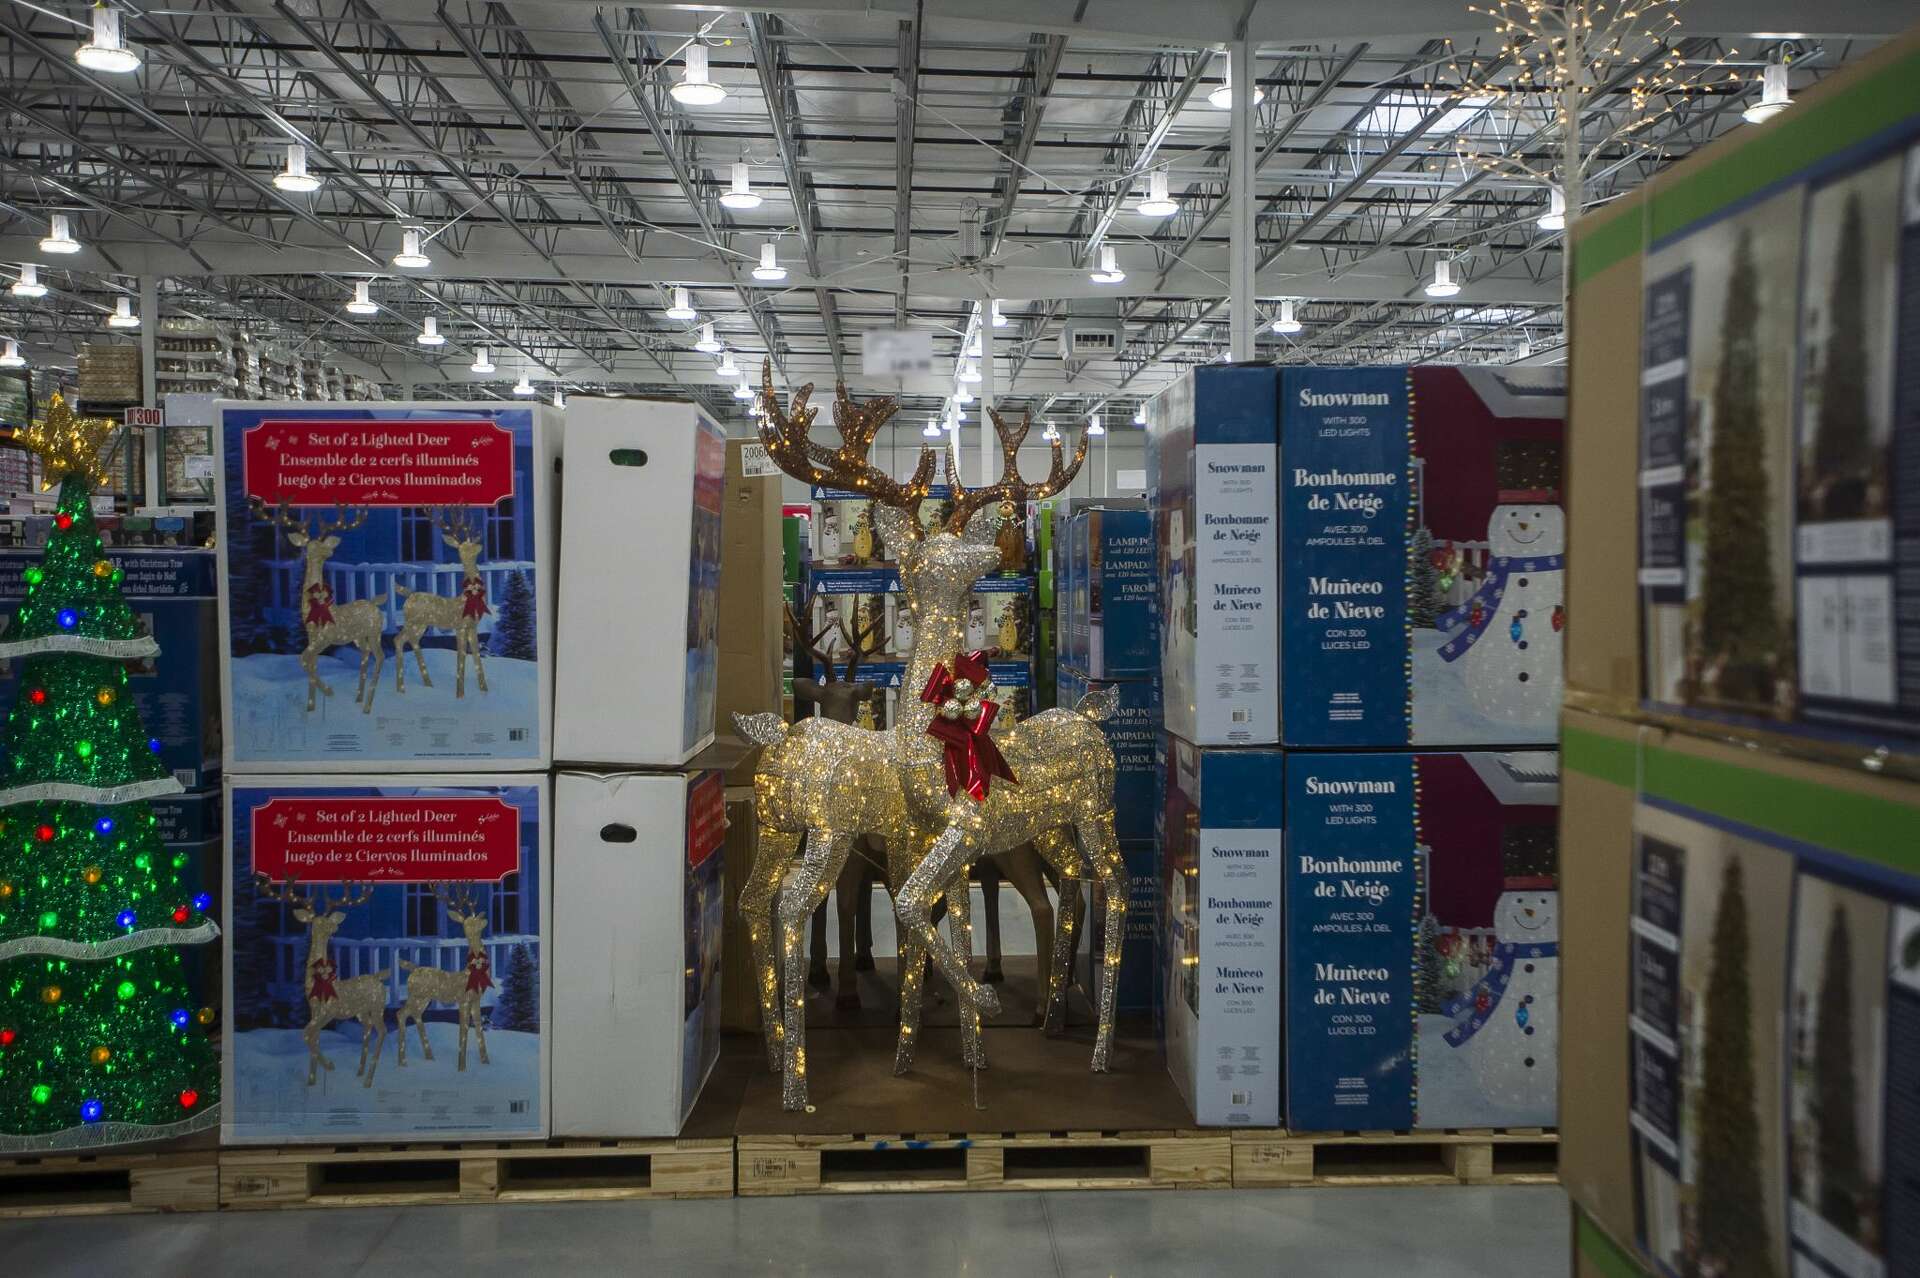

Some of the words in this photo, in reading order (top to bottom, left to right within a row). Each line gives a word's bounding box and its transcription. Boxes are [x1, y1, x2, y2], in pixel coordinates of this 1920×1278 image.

[1299, 388, 1389, 407] Snowman
[136, 408, 160, 425] 300
[1322, 416, 1348, 425] WITH
[1348, 415, 1367, 425] 300
[1318, 428, 1338, 437] LED
[1338, 427, 1371, 437] LIGHTS
[308, 433, 330, 446] Set
[333, 432, 349, 446] of
[350, 436, 359, 446] 2
[361, 432, 414, 449] Lighted
[417, 432, 450, 446] Deer
[280, 452, 348, 466] Ensemble
[349, 452, 367, 466] de
[369, 456, 377, 466] 2
[379, 453, 414, 466] cerfs
[416, 452, 479, 466] illuminés
[1208, 462, 1266, 474] Snowman
[278, 472, 317, 489] Juego
[318, 472, 336, 488] de
[338, 476, 347, 486] 2
[348, 473, 401, 486] Ciervos
[404, 472, 482, 486] Iluminados
[1293, 468, 1396, 487] Bonhomme
[1307, 493, 1330, 511] de
[1334, 492, 1383, 519] Neige
[1204, 513, 1270, 525] Bonhomme
[1213, 529, 1227, 541] de
[1230, 528, 1261, 543] Neige
[1322, 525, 1348, 534] AVEC
[1349, 525, 1369, 534] 300
[1108, 537, 1137, 546] LAMP
[1305, 537, 1357, 546] AMPOULES
[1357, 536, 1366, 545] À
[1366, 536, 1385, 546] DEL
[1214, 583, 1261, 595] Muñeco
[1308, 576, 1383, 595] Muñeco
[1213, 599, 1227, 611] de
[1230, 599, 1262, 611] Nieve
[1307, 602, 1330, 619] de
[1334, 600, 1385, 619] Nieve
[1325, 629, 1347, 638] CON
[1348, 629, 1367, 638] 300
[1321, 640, 1352, 650] LUCES
[1351, 640, 1371, 650] LED
[1306, 776, 1396, 795] Snowman
[1329, 804, 1354, 813] WITH
[1354, 803, 1374, 813] 300
[316, 810, 337, 823] Set
[340, 809, 356, 823] of
[357, 813, 366, 823] 2
[369, 809, 421, 826] Lighted
[424, 809, 457, 823] Deer
[1325, 816, 1344, 825] LED
[1344, 815, 1377, 825] LIGHTS
[288, 829, 354, 843] Ensemble
[357, 829, 374, 843] de
[376, 833, 384, 843] 2
[386, 830, 420, 843] cerfs
[422, 829, 485, 843] illuminés
[285, 849, 323, 865] Juego
[325, 849, 343, 862] de
[344, 852, 353, 862] 2
[355, 850, 408, 862] Ciervos
[410, 848, 488, 862] Iluminados
[1212, 846, 1270, 858] Snowman
[1299, 855, 1403, 874] Bonhomme
[1314, 880, 1336, 898] de
[1341, 879, 1390, 906] Neige
[1208, 897, 1273, 909] Bonhomme
[1216, 913, 1230, 925] de
[1233, 913, 1264, 927] Neige
[1330, 912, 1355, 921] AVEC
[1355, 912, 1375, 921] 300
[1312, 923, 1363, 933] AMPOULES
[1364, 923, 1372, 932] À
[1372, 923, 1392, 933] DEL
[1216, 966, 1264, 979] Muñeco
[1315, 963, 1389, 981] Muñeco
[1215, 982, 1229, 994] de
[1232, 982, 1264, 994] Nieve
[1313, 988, 1335, 1005] de
[1341, 987, 1390, 1005] Nieve
[1331, 1014, 1353, 1024] CON
[1354, 1014, 1373, 1024] 300
[1327, 1026, 1357, 1036] LUCES
[1358, 1026, 1377, 1035] LED
